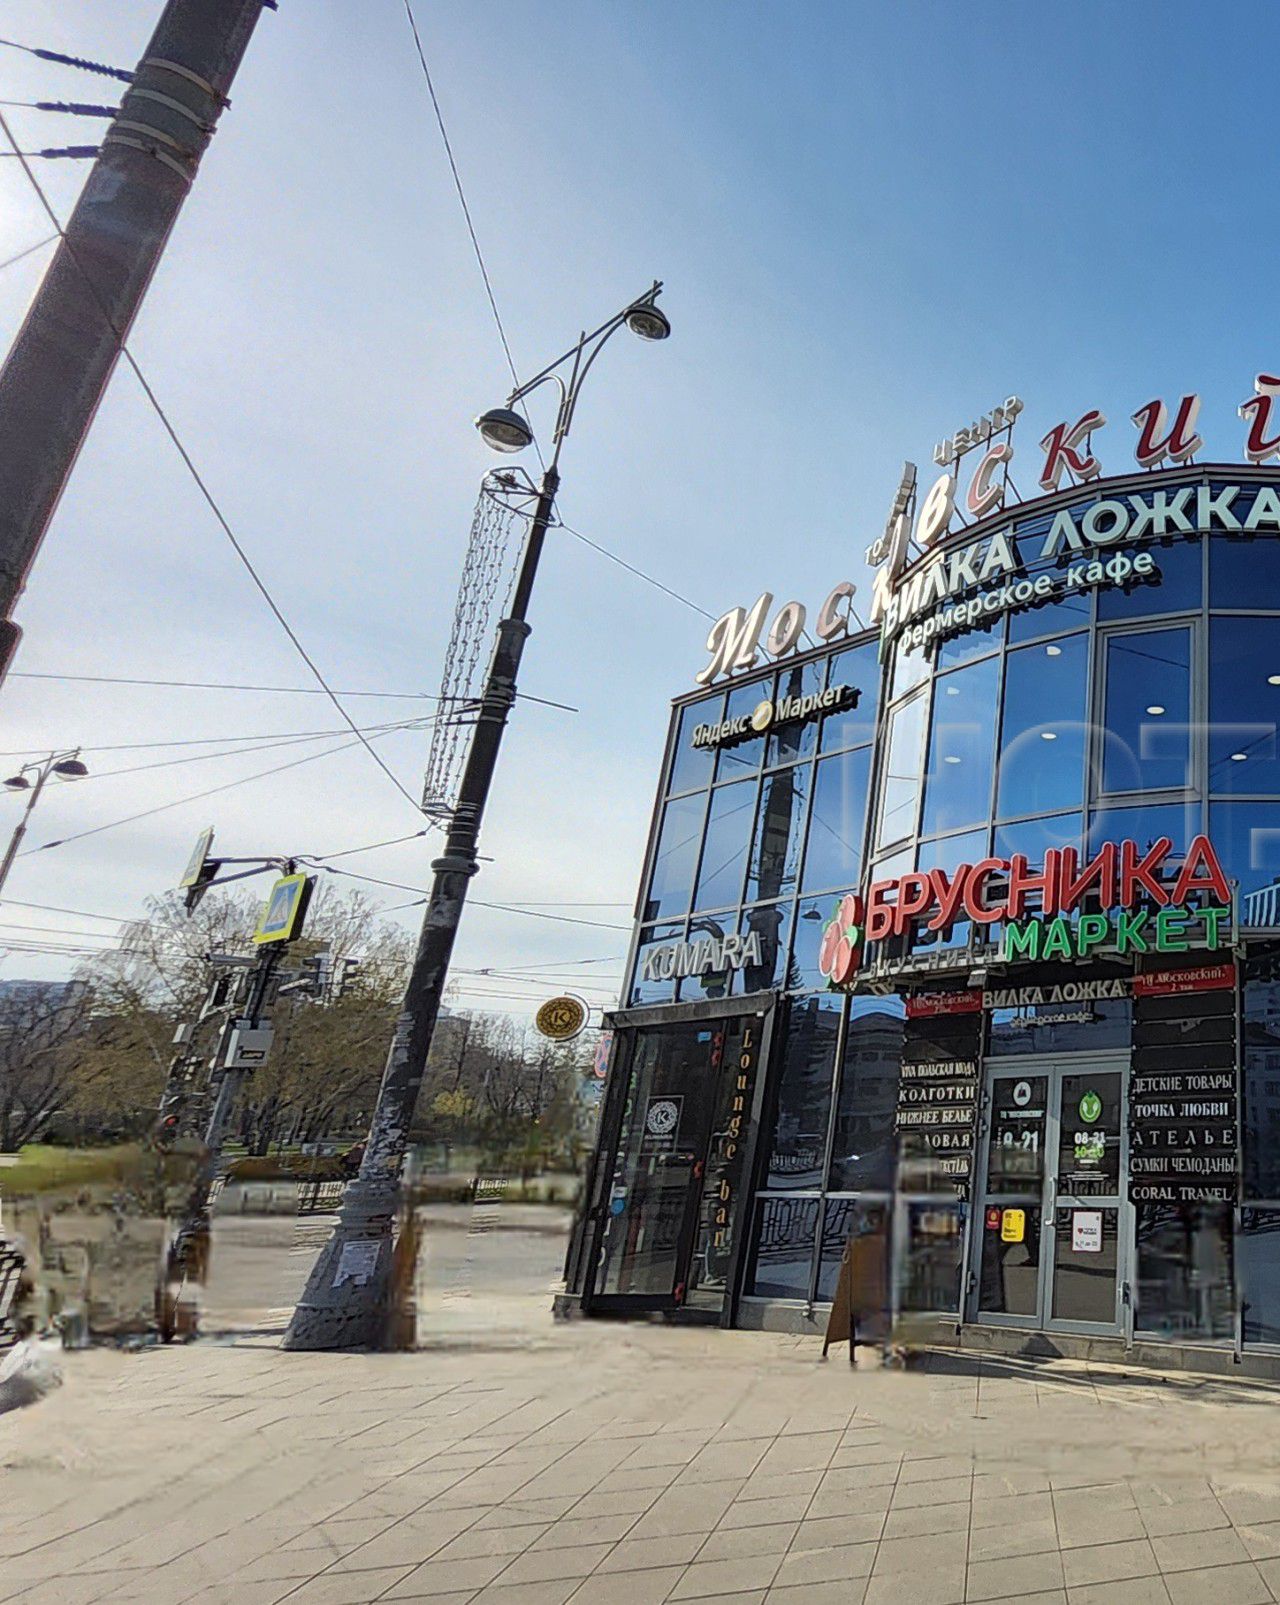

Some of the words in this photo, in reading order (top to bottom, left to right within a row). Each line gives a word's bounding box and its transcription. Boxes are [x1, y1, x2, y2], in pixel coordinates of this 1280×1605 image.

[933, 394, 1024, 466] ЦЕНТР
[884, 533, 1015, 638] ВИЛКА
[898, 573, 1052, 651] фермерское
[1066, 550, 1154, 588] кафе
[690, 716, 749, 748] Яндекс
[774, 684, 846, 721] Маркет
[865, 834, 1232, 942] БРУСНИКА
[640, 930, 764, 982] KUMARA
[1005, 907, 1231, 963] МАРКЕТ
[982, 985, 1044, 1010] ВИЛКА
[1051, 978, 1127, 1003] ЛОЖКА
[726, 1028, 753, 1160] Lounge
[899, 1086, 975, 1102] КОЛГОТКИ
[1132, 1076, 1183, 1094] ДЕТСКИЕ
[1185, 1073, 1233, 1090] ТОВАРЫ
[1135, 1104, 1175, 1118] ТОЧКА
[1179, 1102, 1228, 1117] ЛЮБВИ
[1132, 1129, 1234, 1145] АТЕЛЬЕ
[1130, 1157, 1168, 1173] СУМКИ
[1171, 1156, 1234, 1175] ЧЕМОДАНЫ
[1131, 1186, 1176, 1201] CORAL
